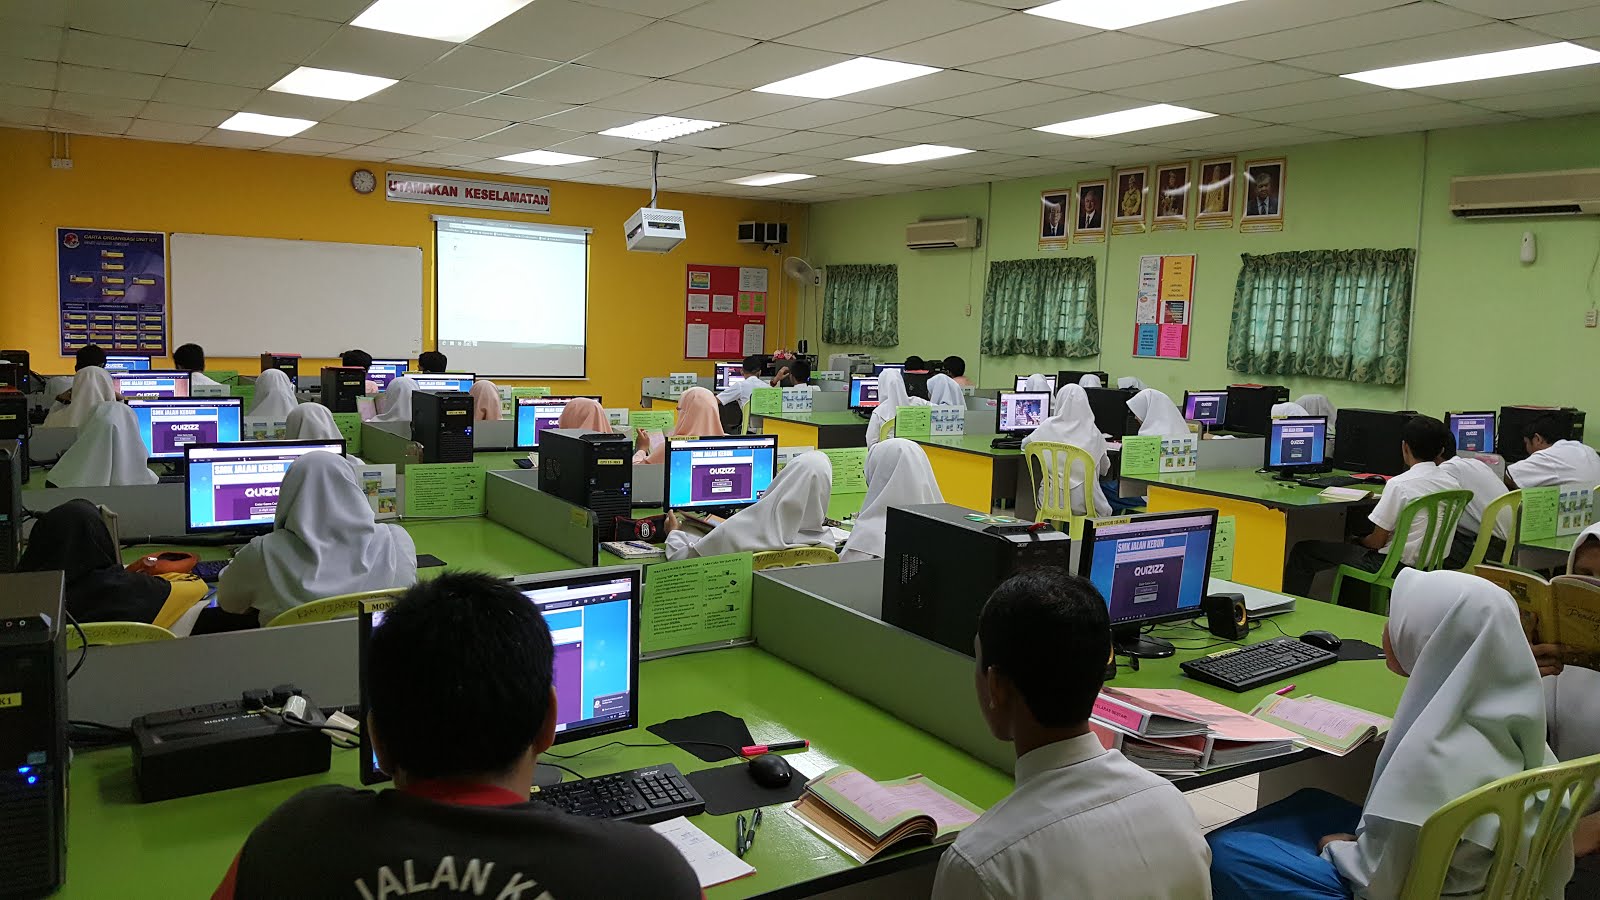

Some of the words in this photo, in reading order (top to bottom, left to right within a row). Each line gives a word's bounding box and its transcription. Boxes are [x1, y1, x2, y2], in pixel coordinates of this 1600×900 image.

[388, 180, 458, 197] UTAMAKAN
[465, 187, 549, 205] KESELAMATAN
[214, 465, 233, 475] SMK
[233, 464, 257, 474] JALAN
[258, 463, 284, 473] KEBUN
[709, 467, 736, 475] QUIZIZZ
[244, 486, 280, 498] QUIZIZ
[1118, 542, 1131, 553] SMK
[1131, 541, 1147, 551] JALAN
[1147, 539, 1165, 549] KEBUN
[1134, 563, 1165, 577] QUIZIZZ
[204, 717, 230, 725] RIGHT
[640, 769, 660, 777] acer
[354, 855, 496, 900] JALAN
